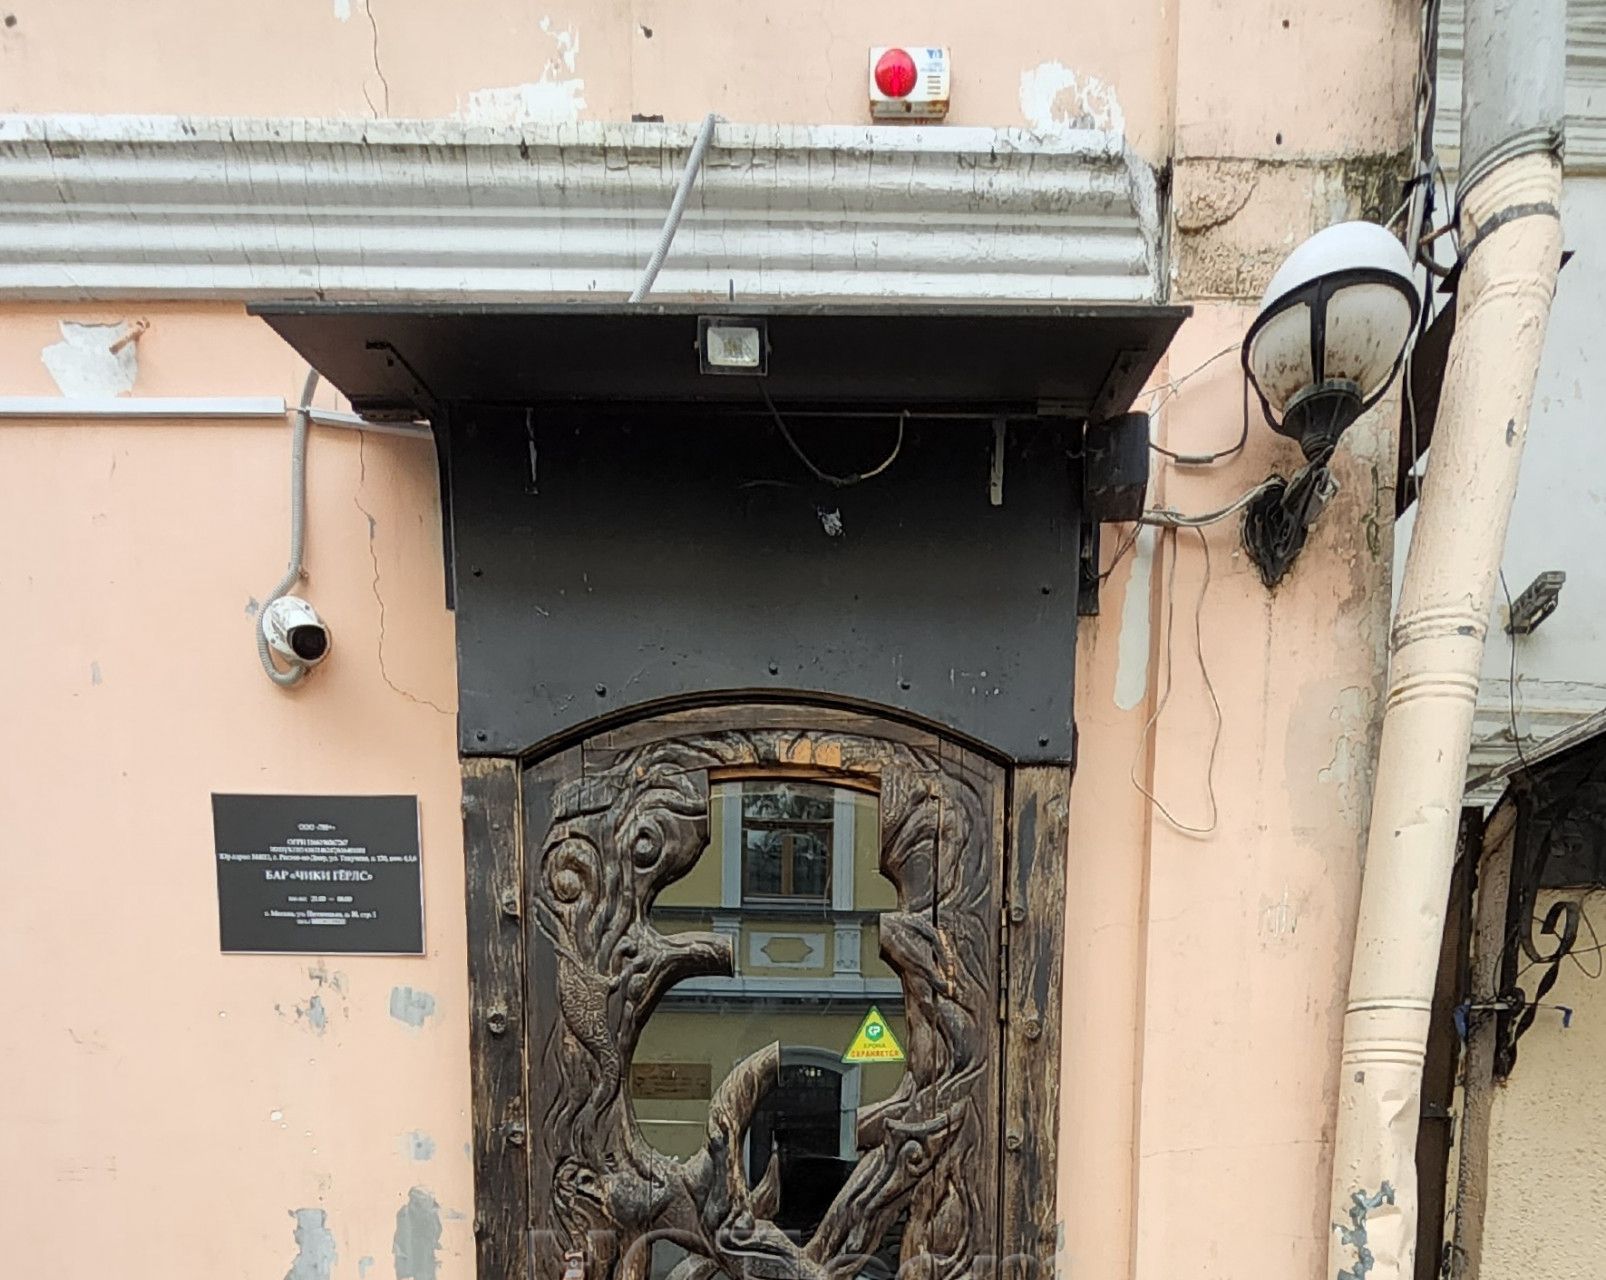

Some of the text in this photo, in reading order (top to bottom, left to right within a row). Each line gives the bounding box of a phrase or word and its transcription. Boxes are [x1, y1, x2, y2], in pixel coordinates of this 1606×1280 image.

[265, 869, 374, 882] БАР «ЧИКИ ГЁРЛС»
